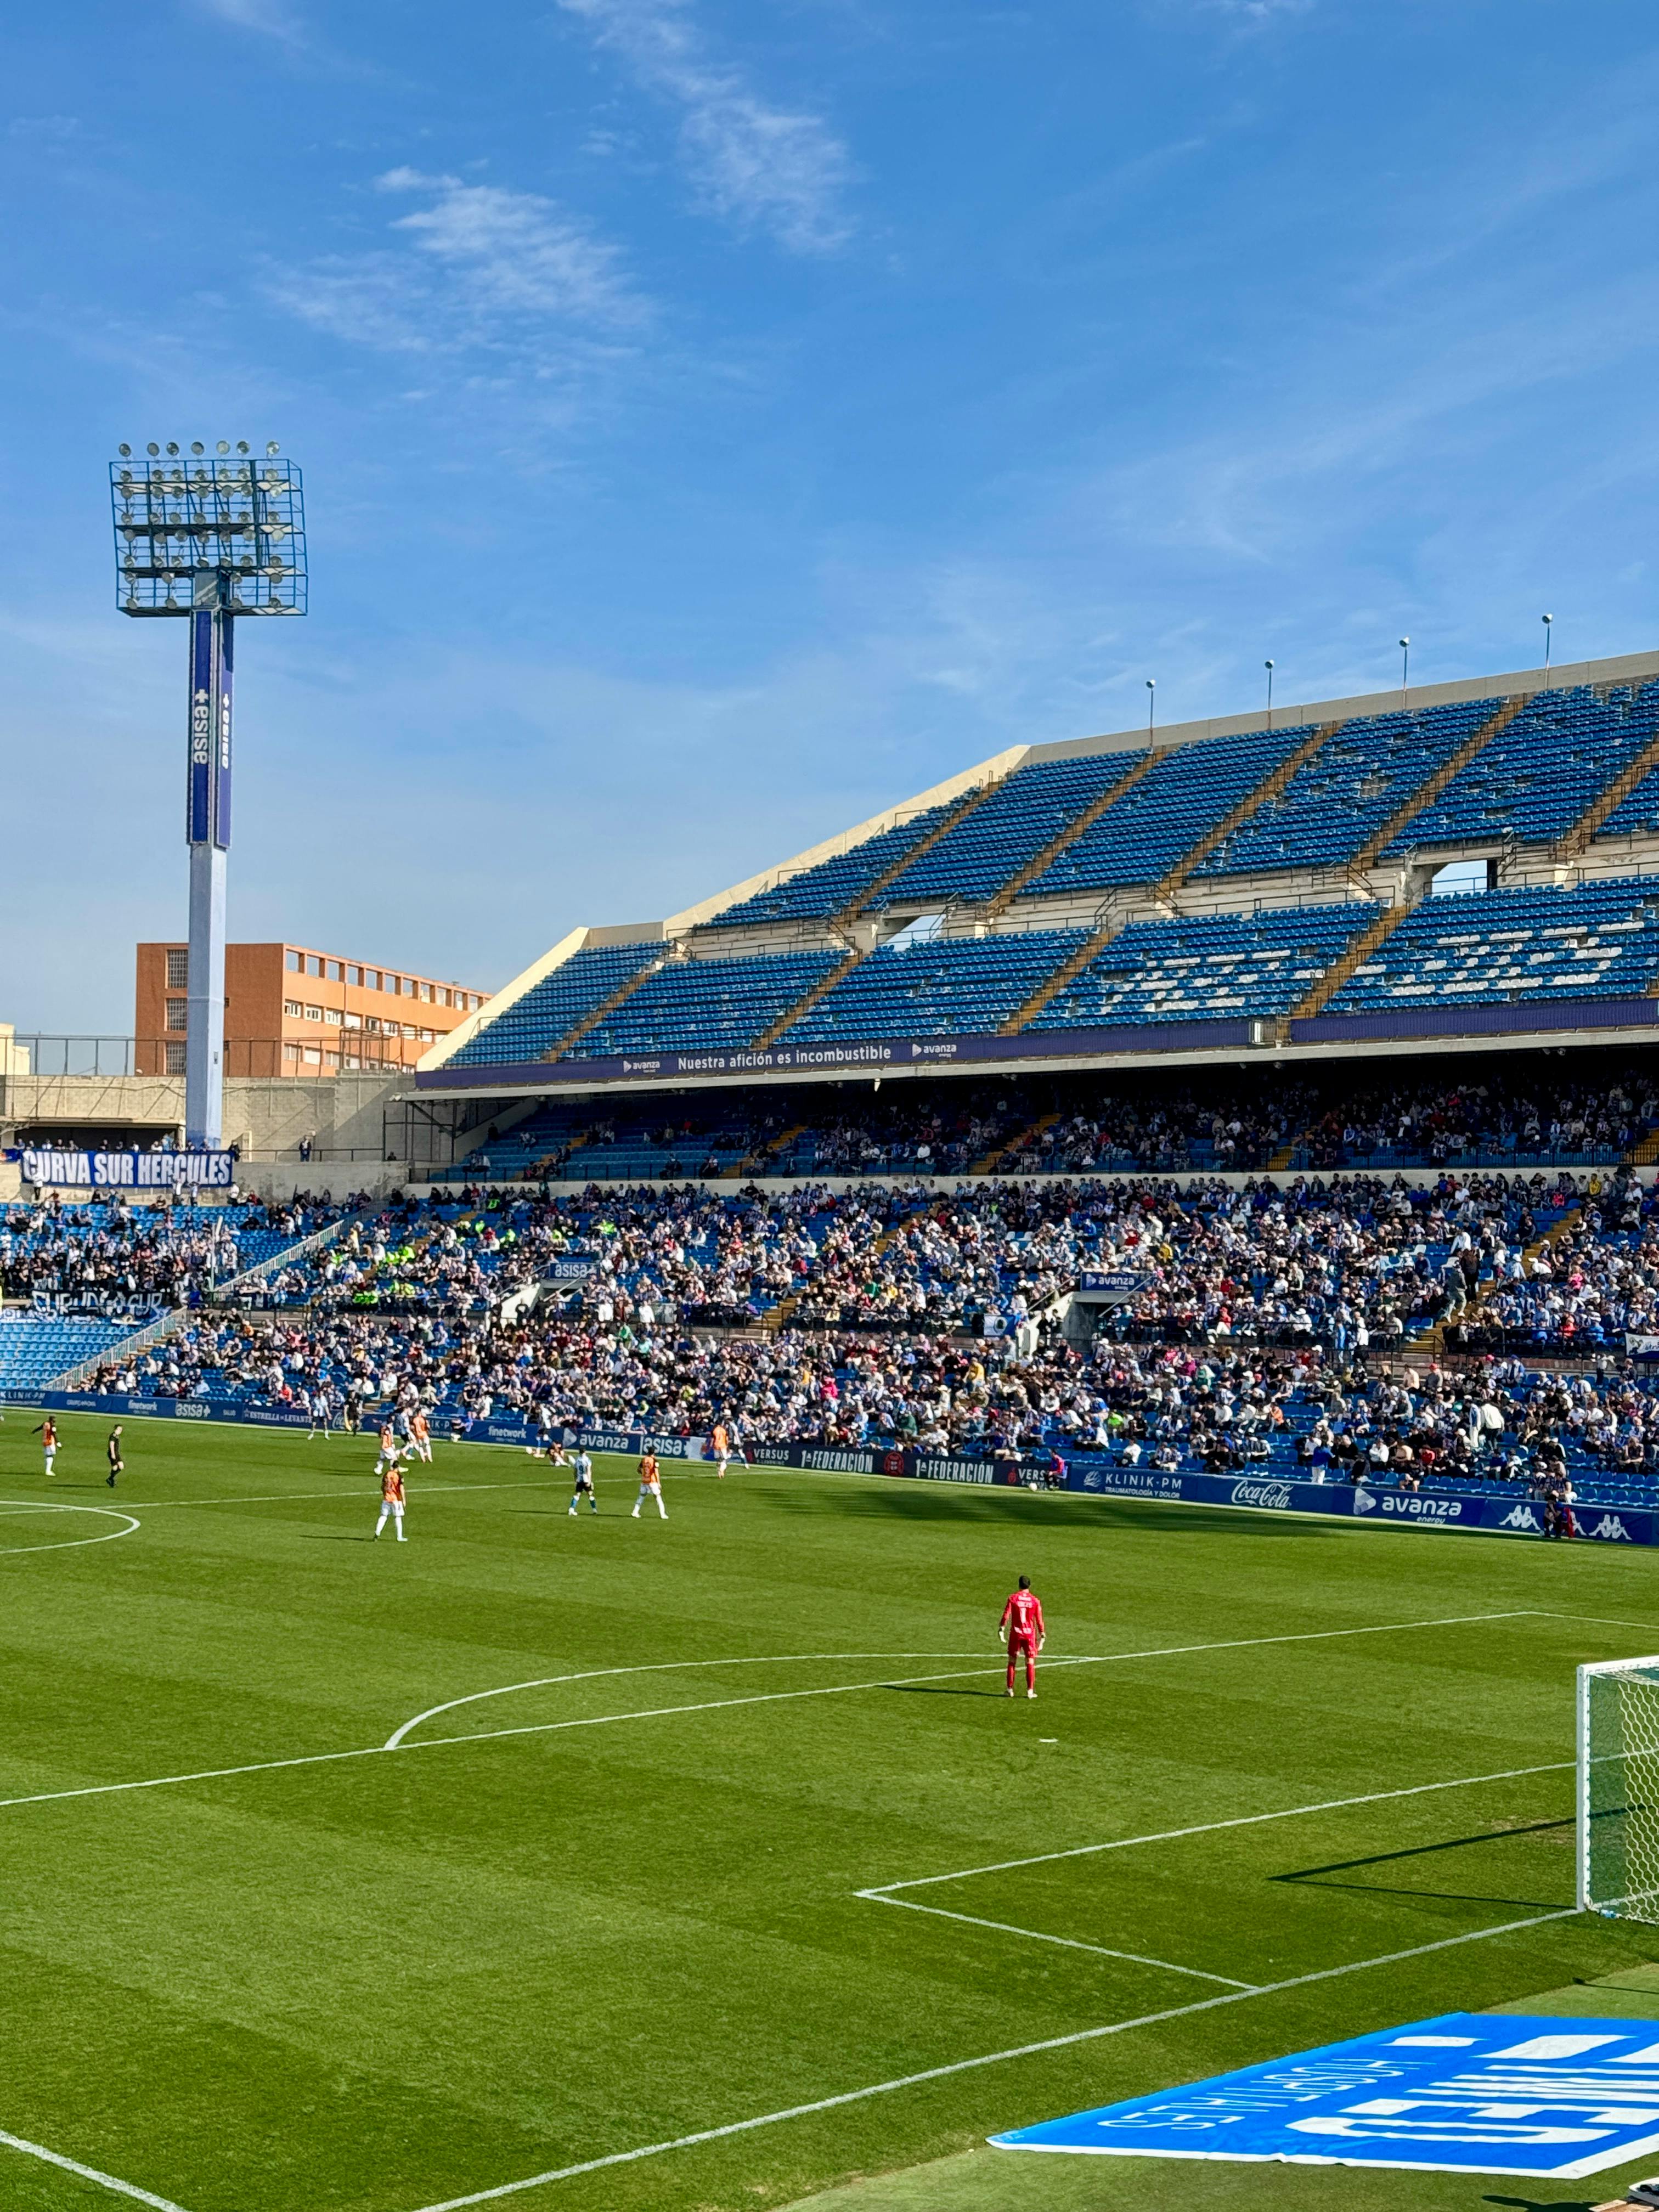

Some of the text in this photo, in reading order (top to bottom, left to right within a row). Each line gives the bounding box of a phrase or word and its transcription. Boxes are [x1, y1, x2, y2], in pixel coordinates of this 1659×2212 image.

[194, 706, 209, 765] asisa
[923, 1043, 957, 1054] avanza
[678, 1045, 891, 1070] Nuestra afición es incombustible
[633, 1061, 661, 1070] avanza
[22, 1150, 230, 1186] CURVA SUR HERCULES
[555, 1264, 588, 1278] asisa
[1098, 1277, 1135, 1285] avanza
[176, 1403, 202, 1418] asisa
[250, 1410, 280, 1421] ESTRELLA
[284, 1414, 312, 1424] LEVANTE
[488, 1425, 527, 1439] finetwork
[579, 1434, 629, 1449] avanza
[644, 1436, 682, 1454] asisa
[753, 1448, 789, 1462] VERSUS
[1018, 1468, 1046, 1481] VERS
[1105, 1486, 1153, 1497] TRAUMATOLOGÍA
[1159, 1491, 1180, 1499] DOLOR
[1382, 1496, 1462, 1517] avanza
[1097, 2058, 1437, 2131] HOSPITALES
